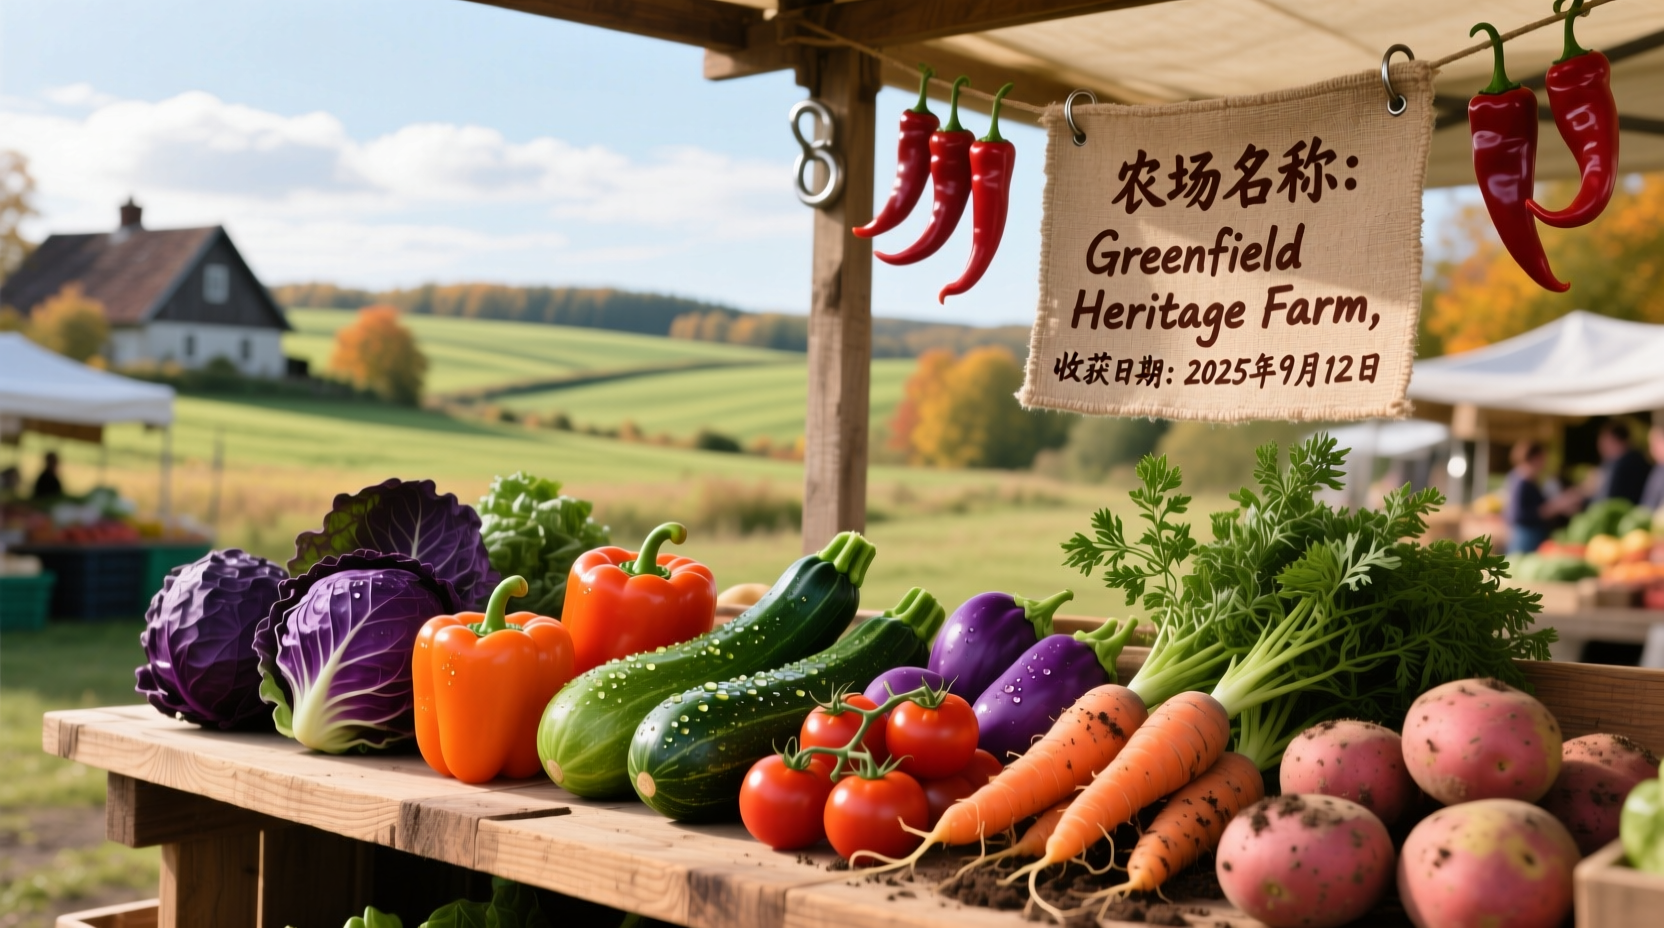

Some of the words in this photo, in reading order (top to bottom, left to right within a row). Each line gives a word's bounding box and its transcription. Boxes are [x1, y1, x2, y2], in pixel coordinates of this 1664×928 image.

[1111, 136, 1359, 214] 农场名称:
[1086, 223, 1306, 277] Greenfield
[1071, 289, 1246, 348] Heritage
[1262, 284, 1380, 331] Farm,
